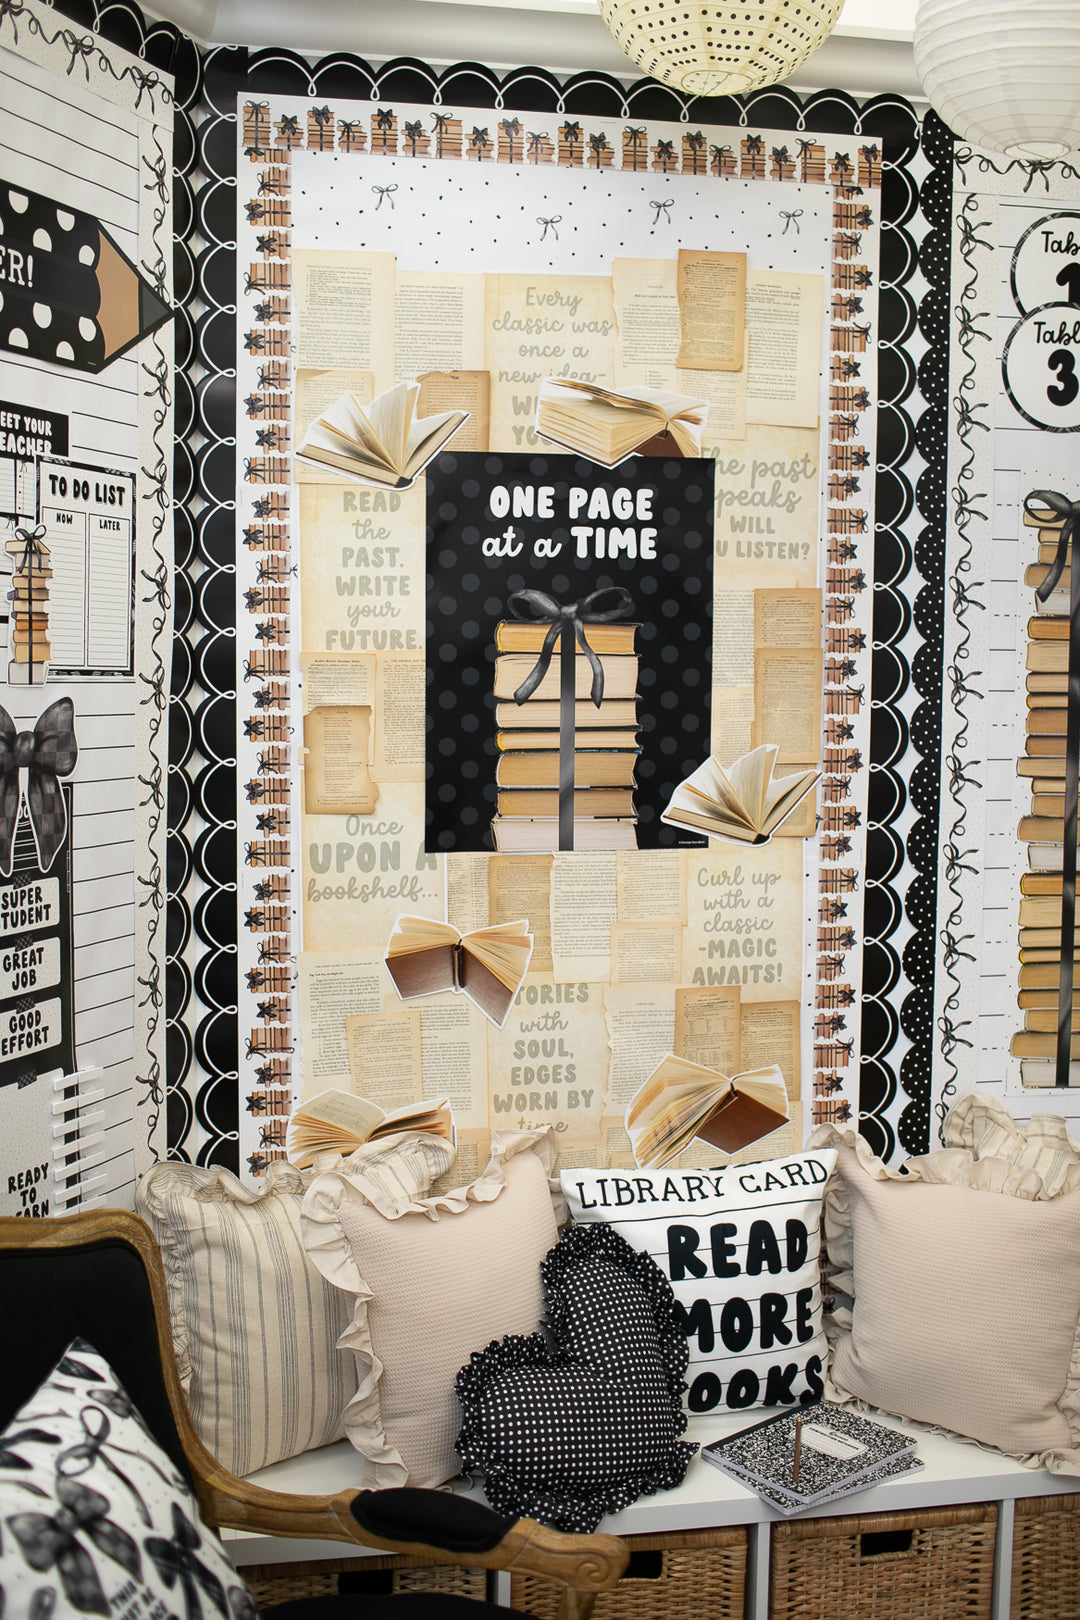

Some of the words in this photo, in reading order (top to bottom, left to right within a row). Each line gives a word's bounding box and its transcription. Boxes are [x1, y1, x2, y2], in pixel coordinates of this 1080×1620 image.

[1041, 230, 1080, 256] Tab
[526, 286, 583, 316] Every
[492, 310, 565, 335] classic
[572, 319, 614, 336] was
[1033, 321, 1080, 346] Tabl
[519, 344, 566, 358] once
[572, 346, 590, 358] a
[498, 369, 542, 384] new
[1047, 348, 1079, 407] 3
[0, 410, 21, 430] EET
[23, 416, 52, 437] YOUR
[0, 431, 52, 457] EACHER
[751, 452, 817, 489] past
[48, 474, 67, 497] TO
[72, 478, 90, 501] DO
[94, 482, 125, 506] LIST
[343, 491, 402, 512] READ
[714, 479, 802, 518] peaks
[489, 485, 556, 519] ONE
[568, 487, 654, 521] PAGE
[56, 512, 73, 525] NOW
[99, 518, 121, 531] LATER
[351, 518, 391, 540] the
[729, 515, 776, 534] WILL
[482, 525, 524, 558] at
[533, 538, 563, 558] a
[570, 526, 658, 560] TIME
[735, 540, 811, 561] LISTEN?
[341, 546, 404, 568] PAST.
[335, 575, 411, 597] WRITE
[346, 600, 401, 629] your
[325, 629, 423, 651] FUTURE.
[345, 814, 404, 837] Once
[309, 840, 401, 875] UPON
[697, 865, 745, 888] Curl
[751, 872, 782, 894] up
[1, 886, 43, 911] SUPER
[703, 888, 751, 911] with
[757, 896, 775, 908] a
[0, 903, 52, 930] TUDENT
[703, 912, 774, 935] classic
[3, 946, 44, 972] GREAT
[12, 968, 37, 991] JOB
[691, 962, 784, 986] AWAITS!
[514, 983, 590, 1006] TORIES
[9, 1009, 42, 1034] GOOD
[519, 1011, 569, 1033] with
[1, 1025, 49, 1056] EFFORT
[513, 1038, 575, 1060] SOUL,
[510, 1063, 577, 1086] EDGES
[493, 1091, 558, 1114] WORN
[567, 1089, 595, 1110] BY
[7, 1161, 49, 1195] READY
[575, 1175, 725, 1209] LIBRARY
[739, 1159, 828, 1193] CARD
[20, 1186, 37, 1208] TO
[666, 1218, 809, 1281] READ
[670, 1287, 815, 1354] MORE
[686, 1354, 825, 1413] OOKS
